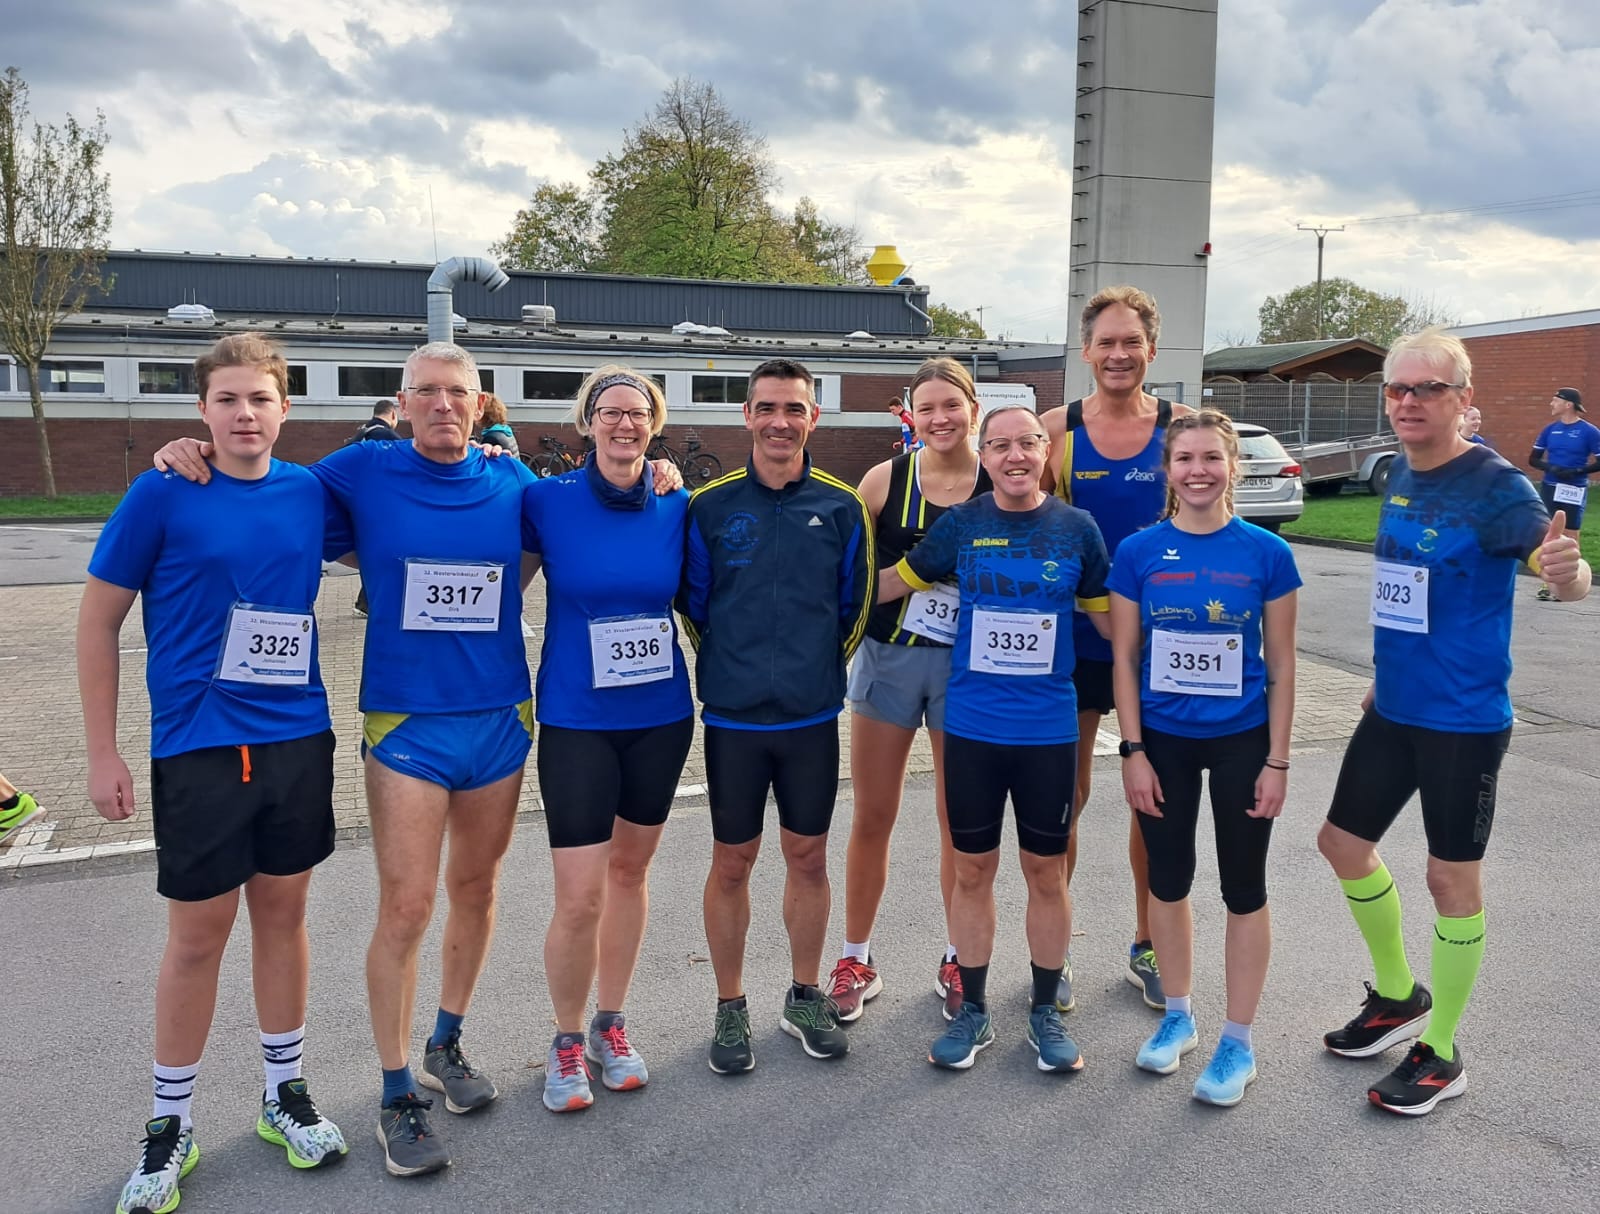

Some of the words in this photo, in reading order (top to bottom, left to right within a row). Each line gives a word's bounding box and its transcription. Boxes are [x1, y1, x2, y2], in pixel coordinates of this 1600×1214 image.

[426, 585, 484, 605] 3317
[1376, 581, 1411, 604] 3023
[925, 599, 960, 623] 331
[249, 634, 299, 657] 3325
[611, 638, 660, 660] 3336
[988, 631, 1038, 651] 3332
[1169, 652, 1222, 672] 3351
